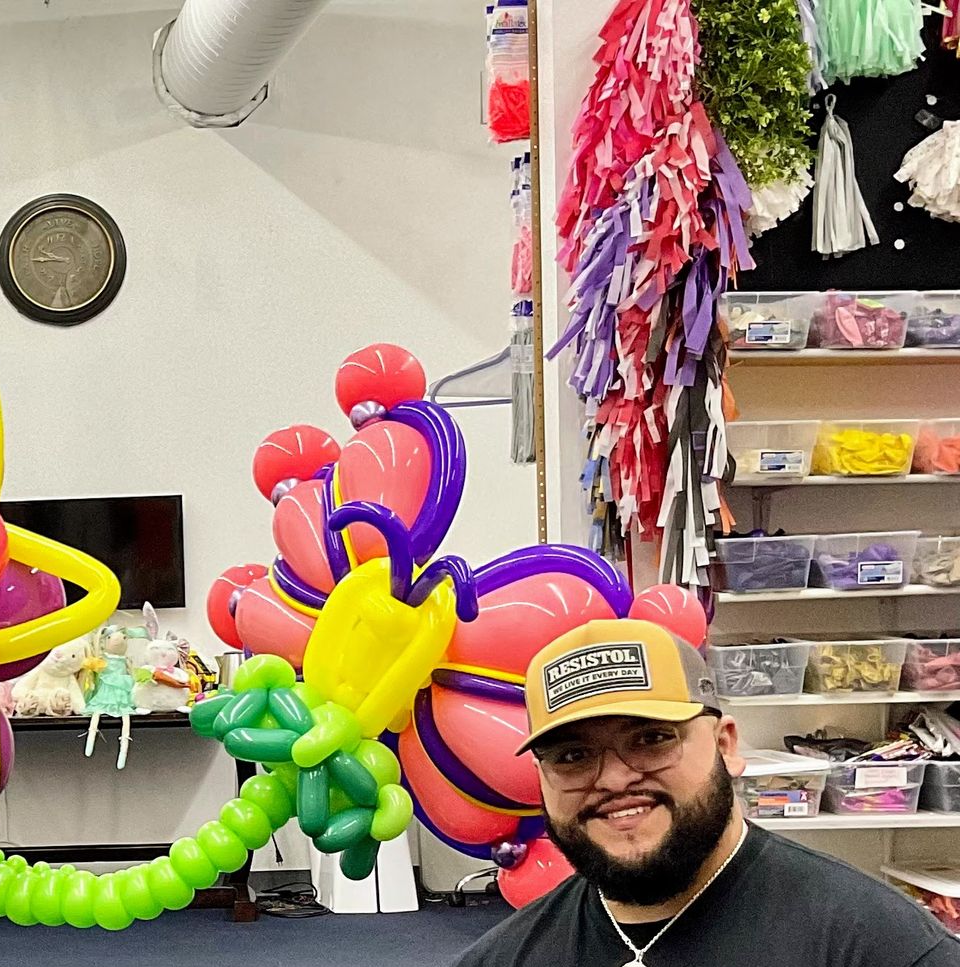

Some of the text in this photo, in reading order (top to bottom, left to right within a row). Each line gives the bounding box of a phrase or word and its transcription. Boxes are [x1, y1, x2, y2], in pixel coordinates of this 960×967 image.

[548, 649, 637, 682] RESISTOL
[553, 686, 563, 695] WE
[564, 678, 581, 689] LIVE
[582, 675, 590, 683] IT
[592, 670, 619, 680] EVERY
